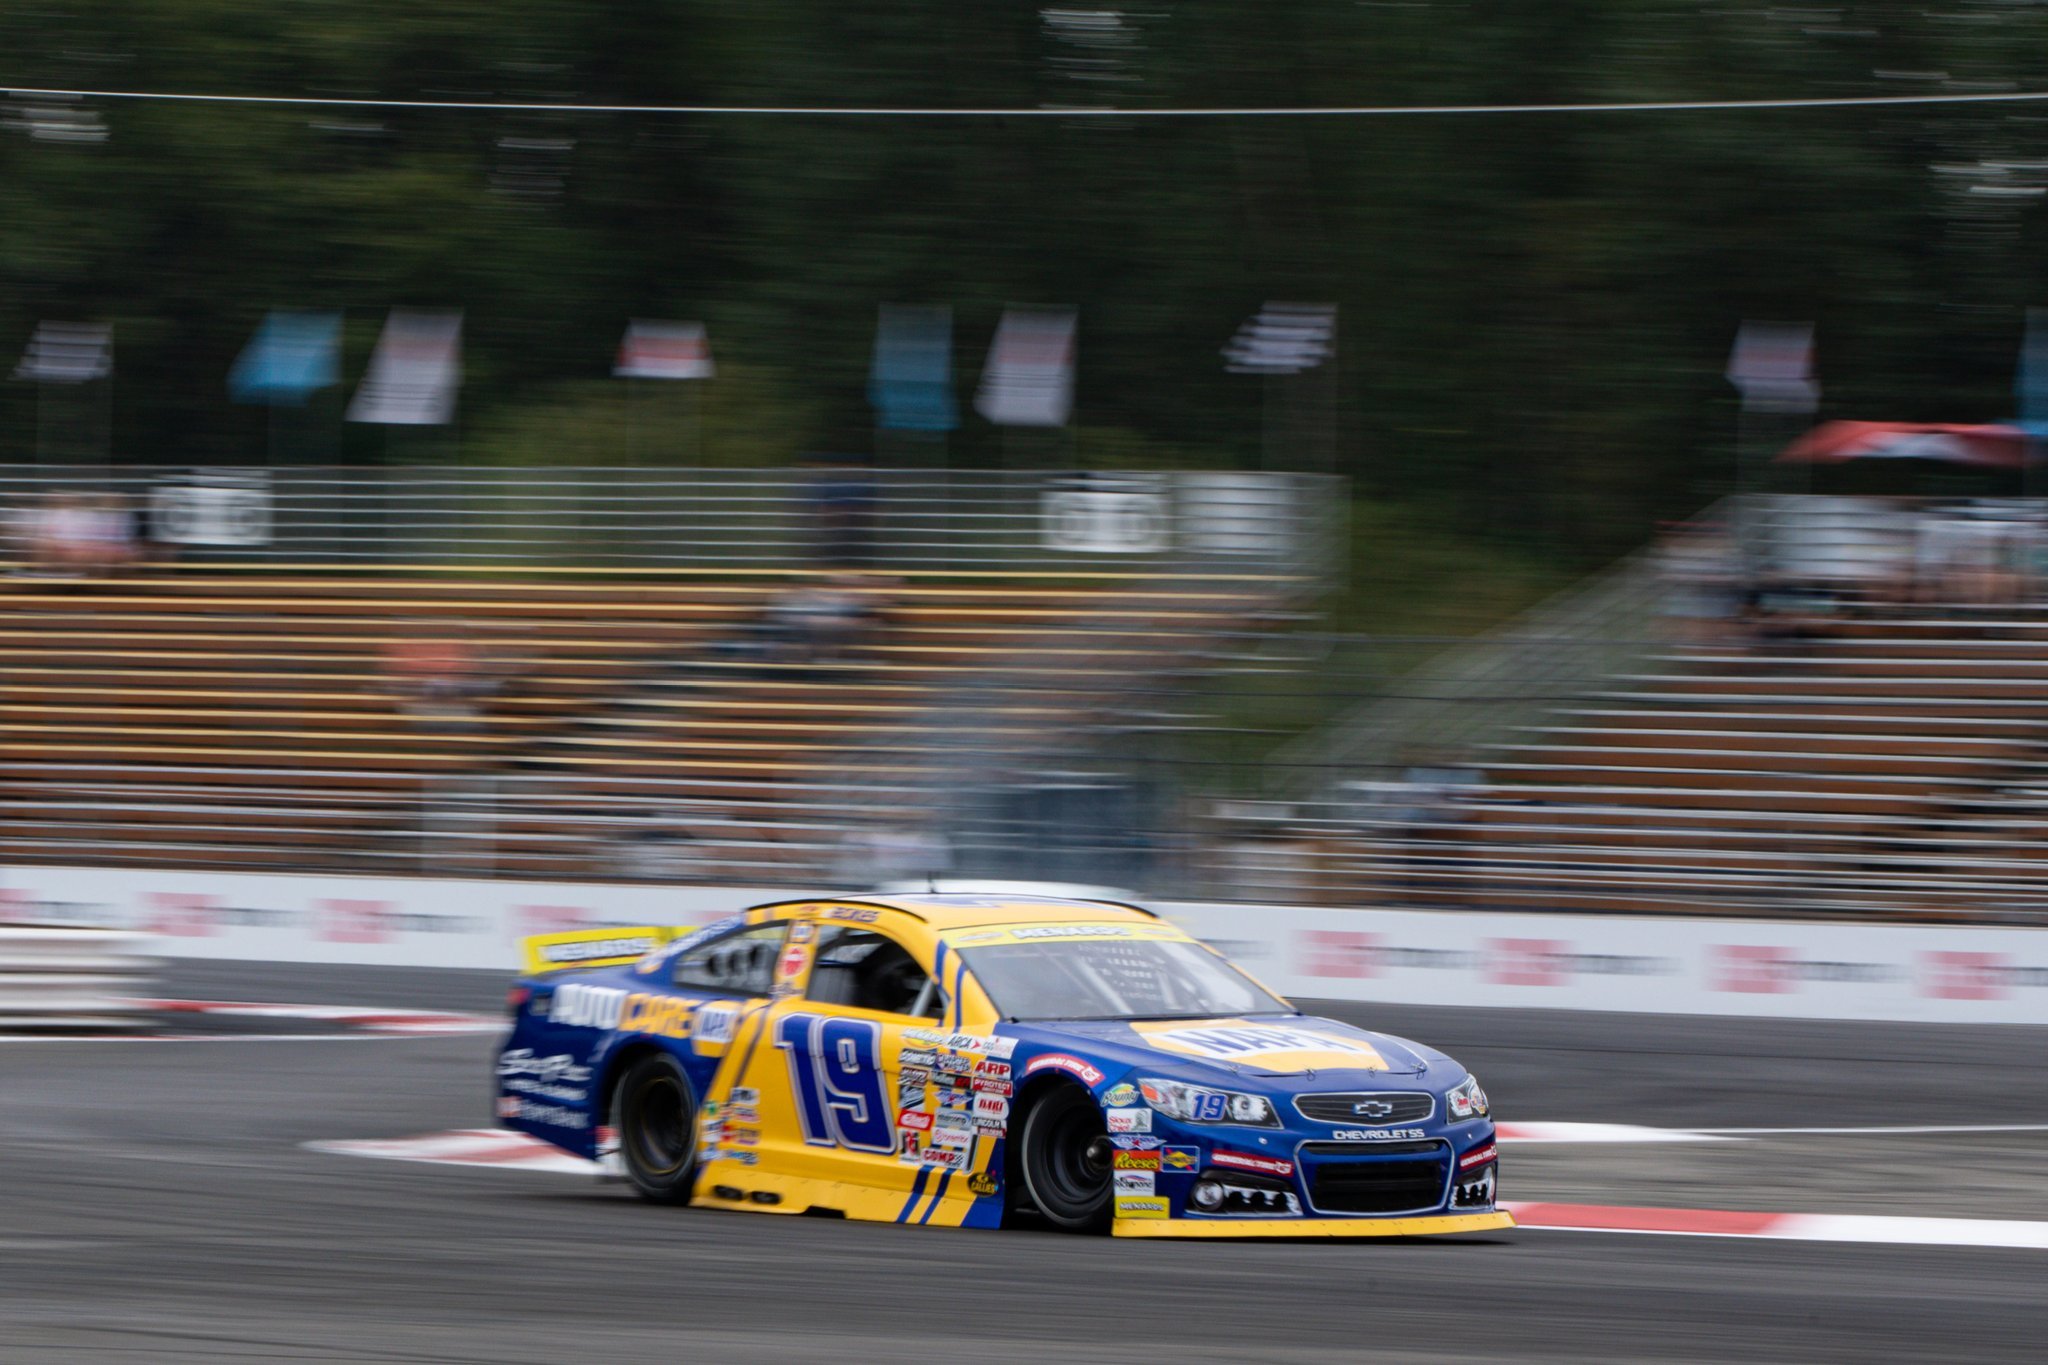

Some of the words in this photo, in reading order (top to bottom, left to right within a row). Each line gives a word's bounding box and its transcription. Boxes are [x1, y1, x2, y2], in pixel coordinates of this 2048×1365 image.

[1010, 926, 1132, 940] MENARDS
[948, 1035, 973, 1050] ARCA
[1165, 1029, 1364, 1054] NAPA
[976, 1062, 1010, 1076] ARP
[773, 1012, 897, 1156] 19
[974, 1079, 1010, 1092] PYROTECT
[1100, 1090, 1140, 1107] Bounty
[1192, 1093, 1228, 1121] 19
[1333, 1129, 1408, 1140] CHEVROLET
[1409, 1128, 1425, 1138] SS
[923, 1149, 955, 1163] COMP
[971, 1181, 996, 1194] CALLIES
[1119, 1202, 1164, 1212] MENARDS
